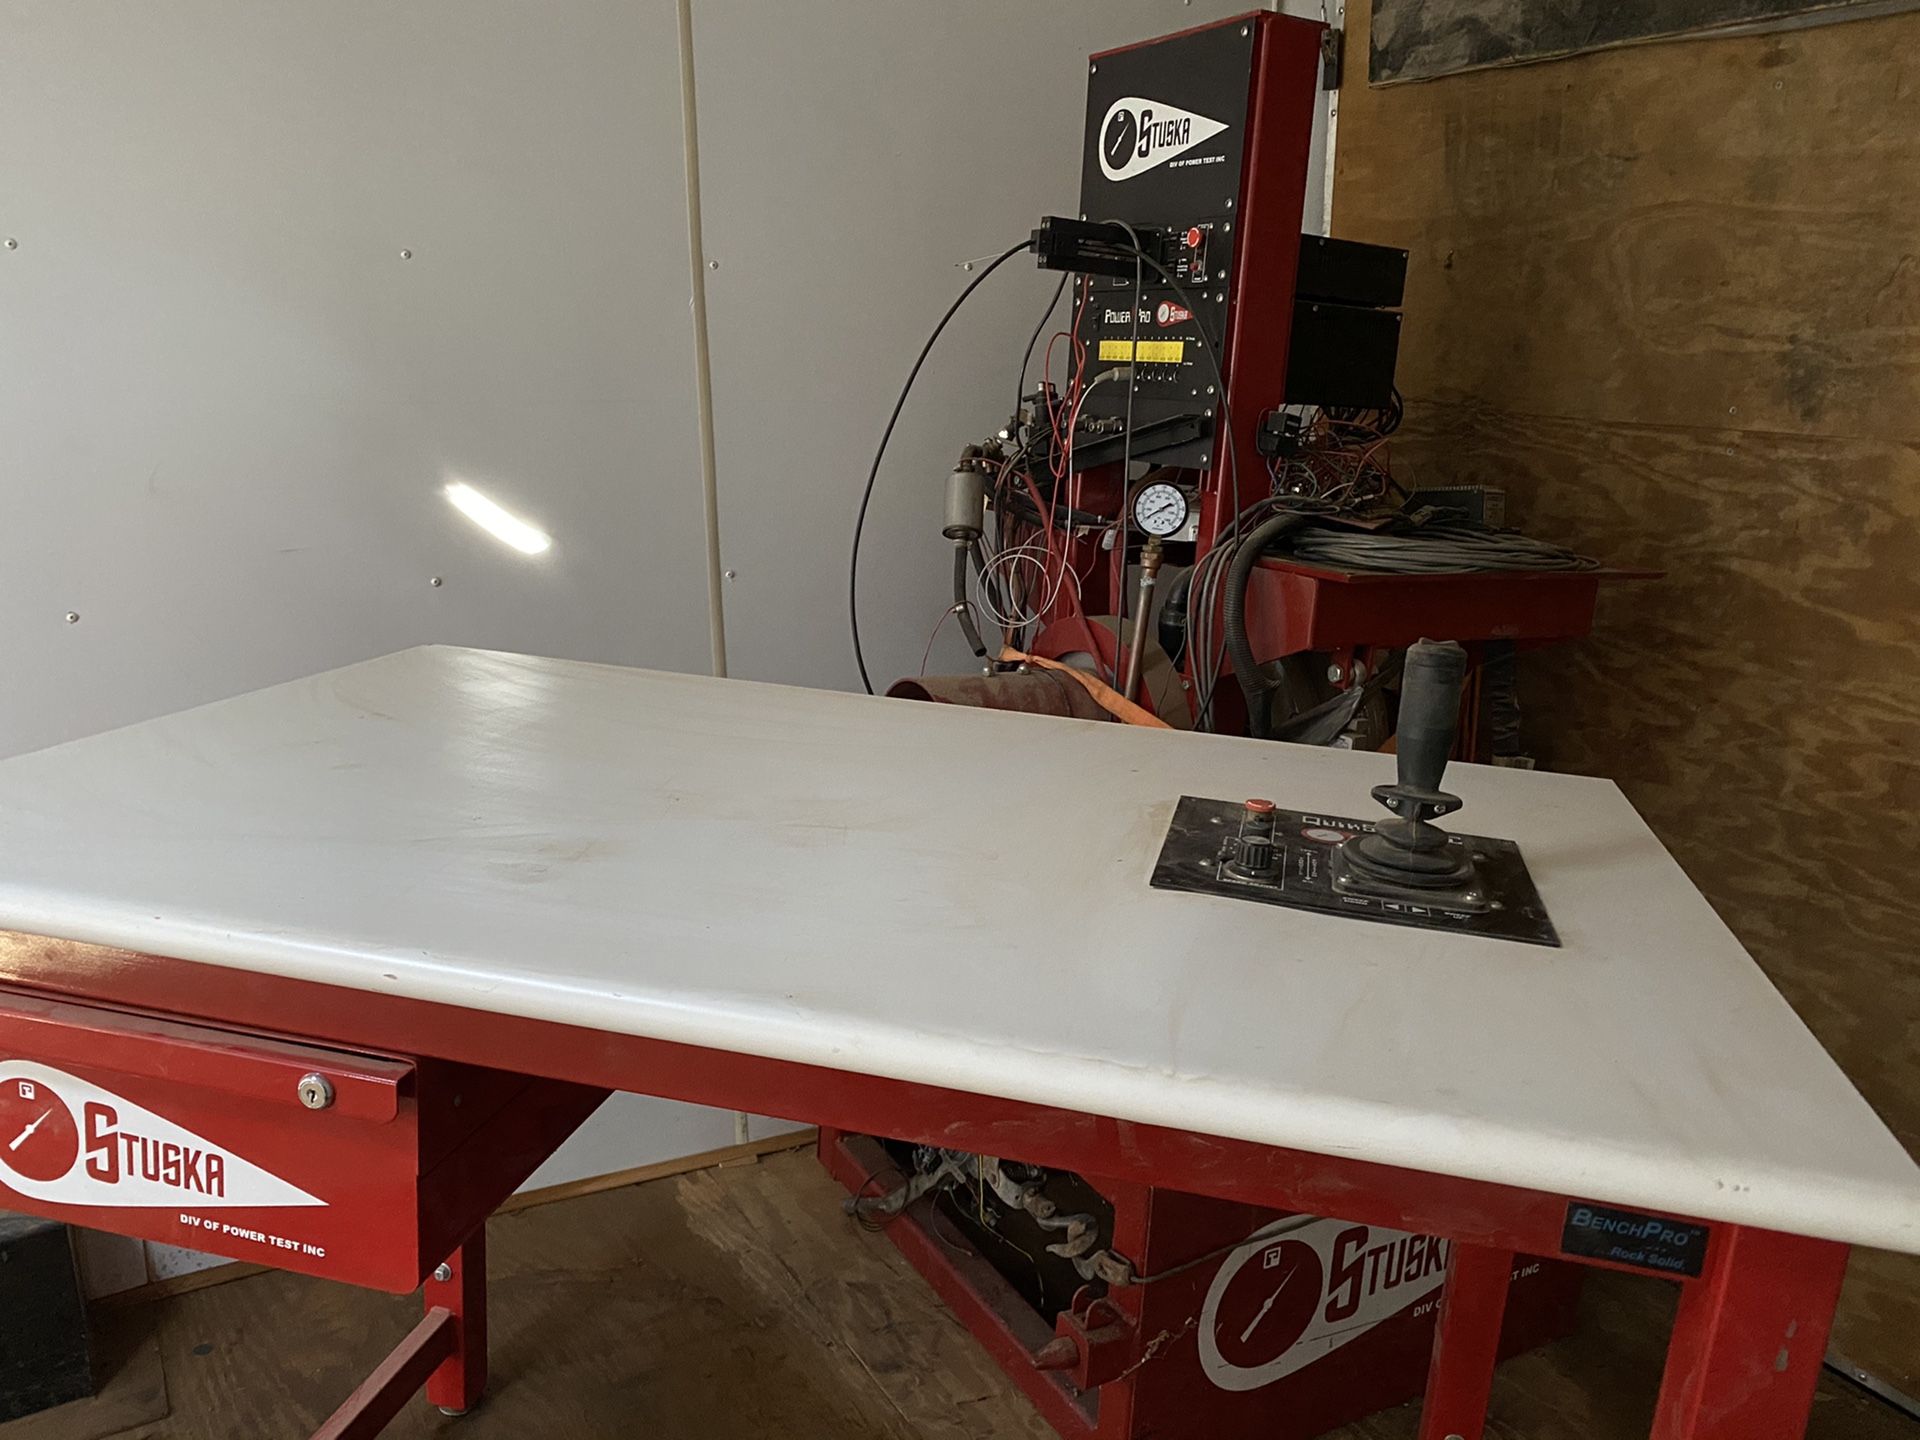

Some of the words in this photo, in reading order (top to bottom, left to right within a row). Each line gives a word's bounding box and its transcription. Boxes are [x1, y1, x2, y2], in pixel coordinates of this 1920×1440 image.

[1137, 109, 1191, 158] STUSKA
[1185, 158, 1202, 166] POWER
[1203, 156, 1216, 164] TEST
[1216, 155, 1226, 163] INC
[1104, 309, 1131, 324] POWER
[84, 1101, 225, 1198] STUSKA
[179, 1213, 201, 1226] DIV
[203, 1219, 220, 1231] OF
[222, 1224, 266, 1243] POWER
[268, 1235, 300, 1251] TEST
[302, 1244, 326, 1258] INC
[1609, 1246, 1646, 1263] Rock
[1520, 1263, 1540, 1279] INC
[1412, 1300, 1434, 1318] DIV
